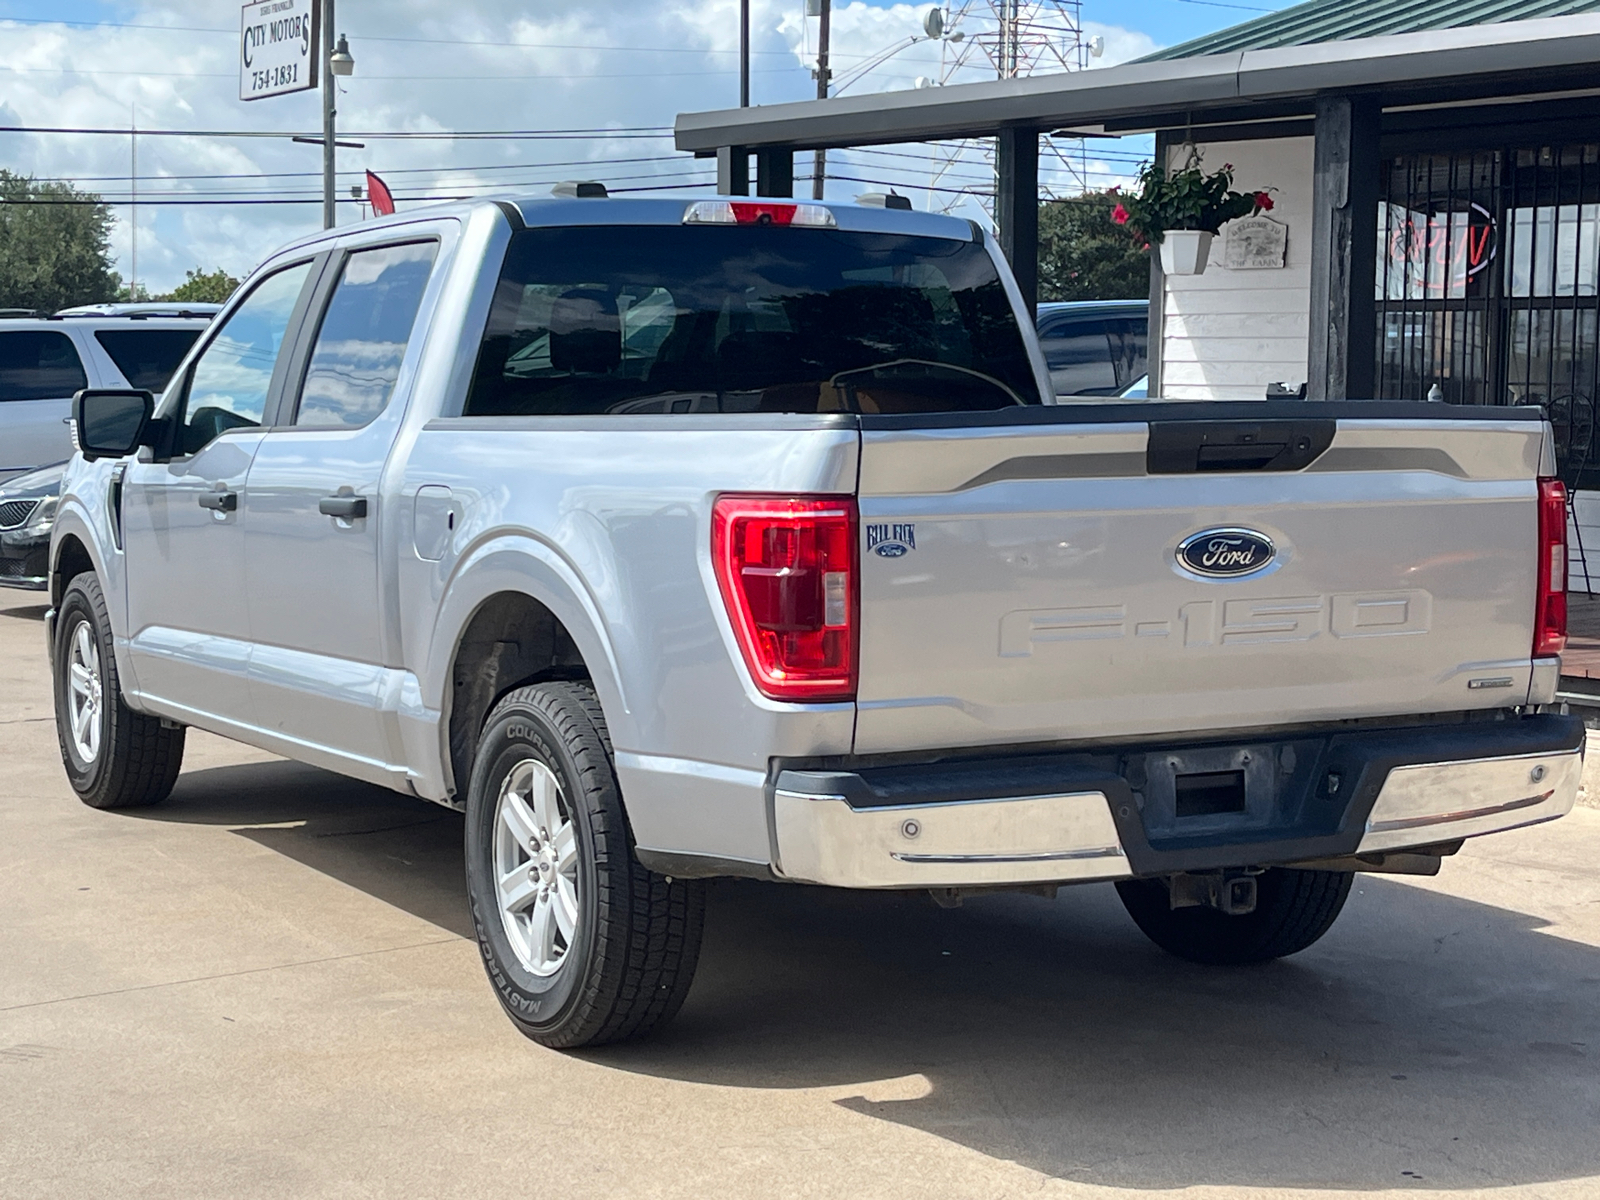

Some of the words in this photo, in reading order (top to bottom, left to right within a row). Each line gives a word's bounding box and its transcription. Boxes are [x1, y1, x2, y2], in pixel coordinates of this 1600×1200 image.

[243, 24, 267, 68] CITY
[270, 13, 309, 56] MOTORS
[252, 63, 298, 91] 754-1831
[1231, 222, 1269, 236] WELCOME
[1270, 225, 1281, 235] TO
[1202, 538, 1256, 566] Ford
[998, 588, 1433, 658] F-150
